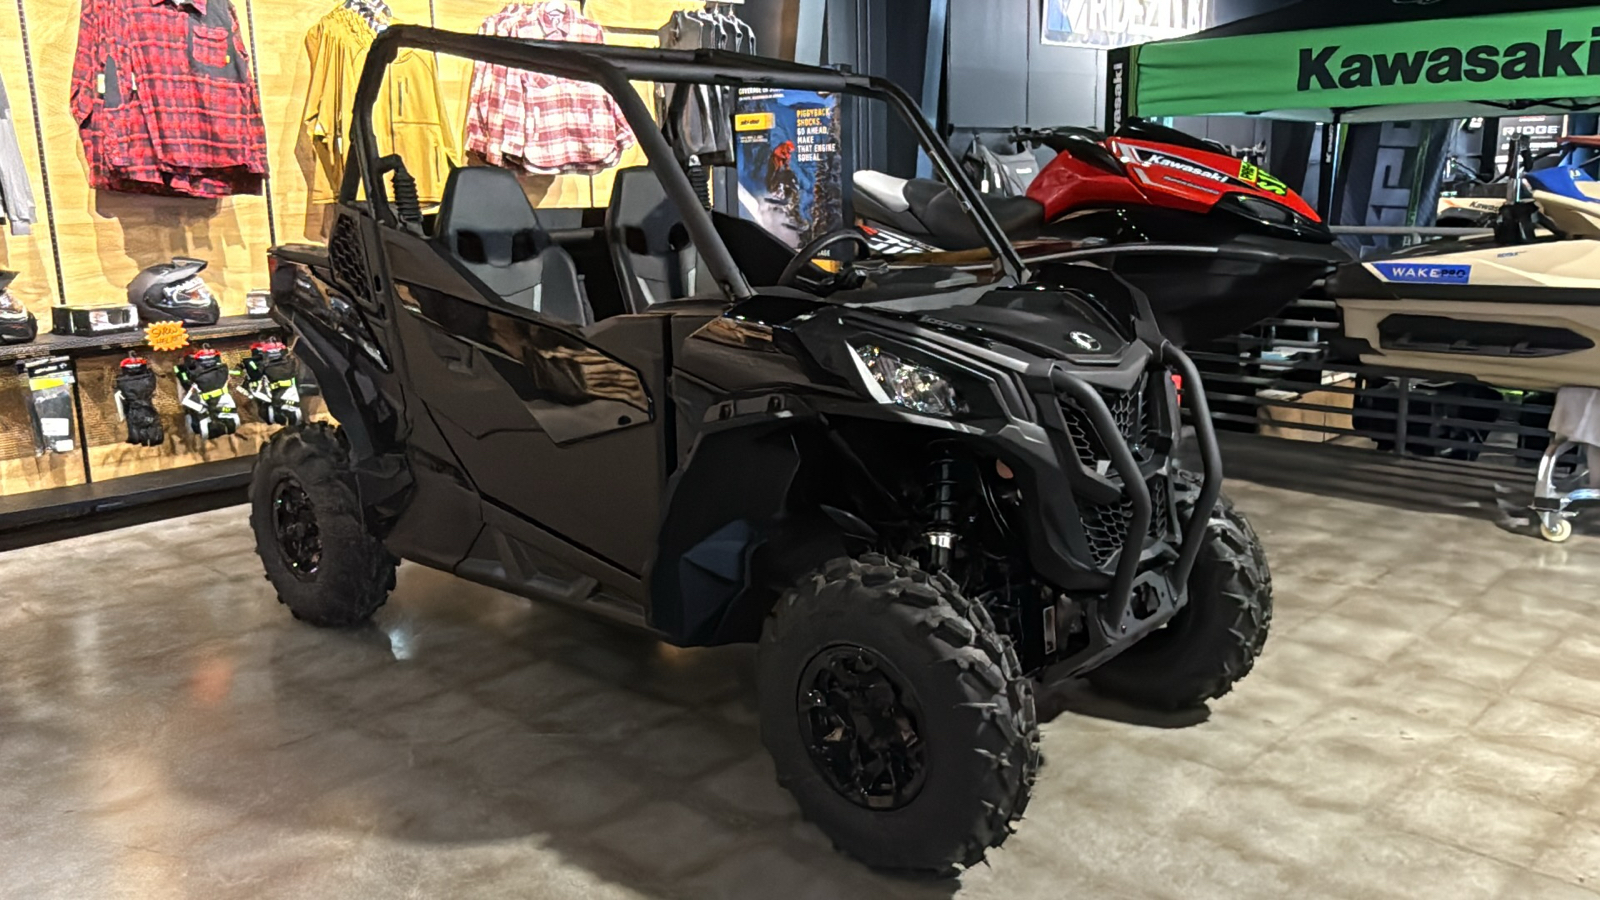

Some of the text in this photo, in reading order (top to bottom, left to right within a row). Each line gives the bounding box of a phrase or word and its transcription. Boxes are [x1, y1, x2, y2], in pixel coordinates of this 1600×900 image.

[1297, 26, 1600, 91] Kawasaki
[797, 135, 814, 144] MAKE
[797, 144, 812, 153] THAT
[1148, 154, 1229, 184] Kawasaki
